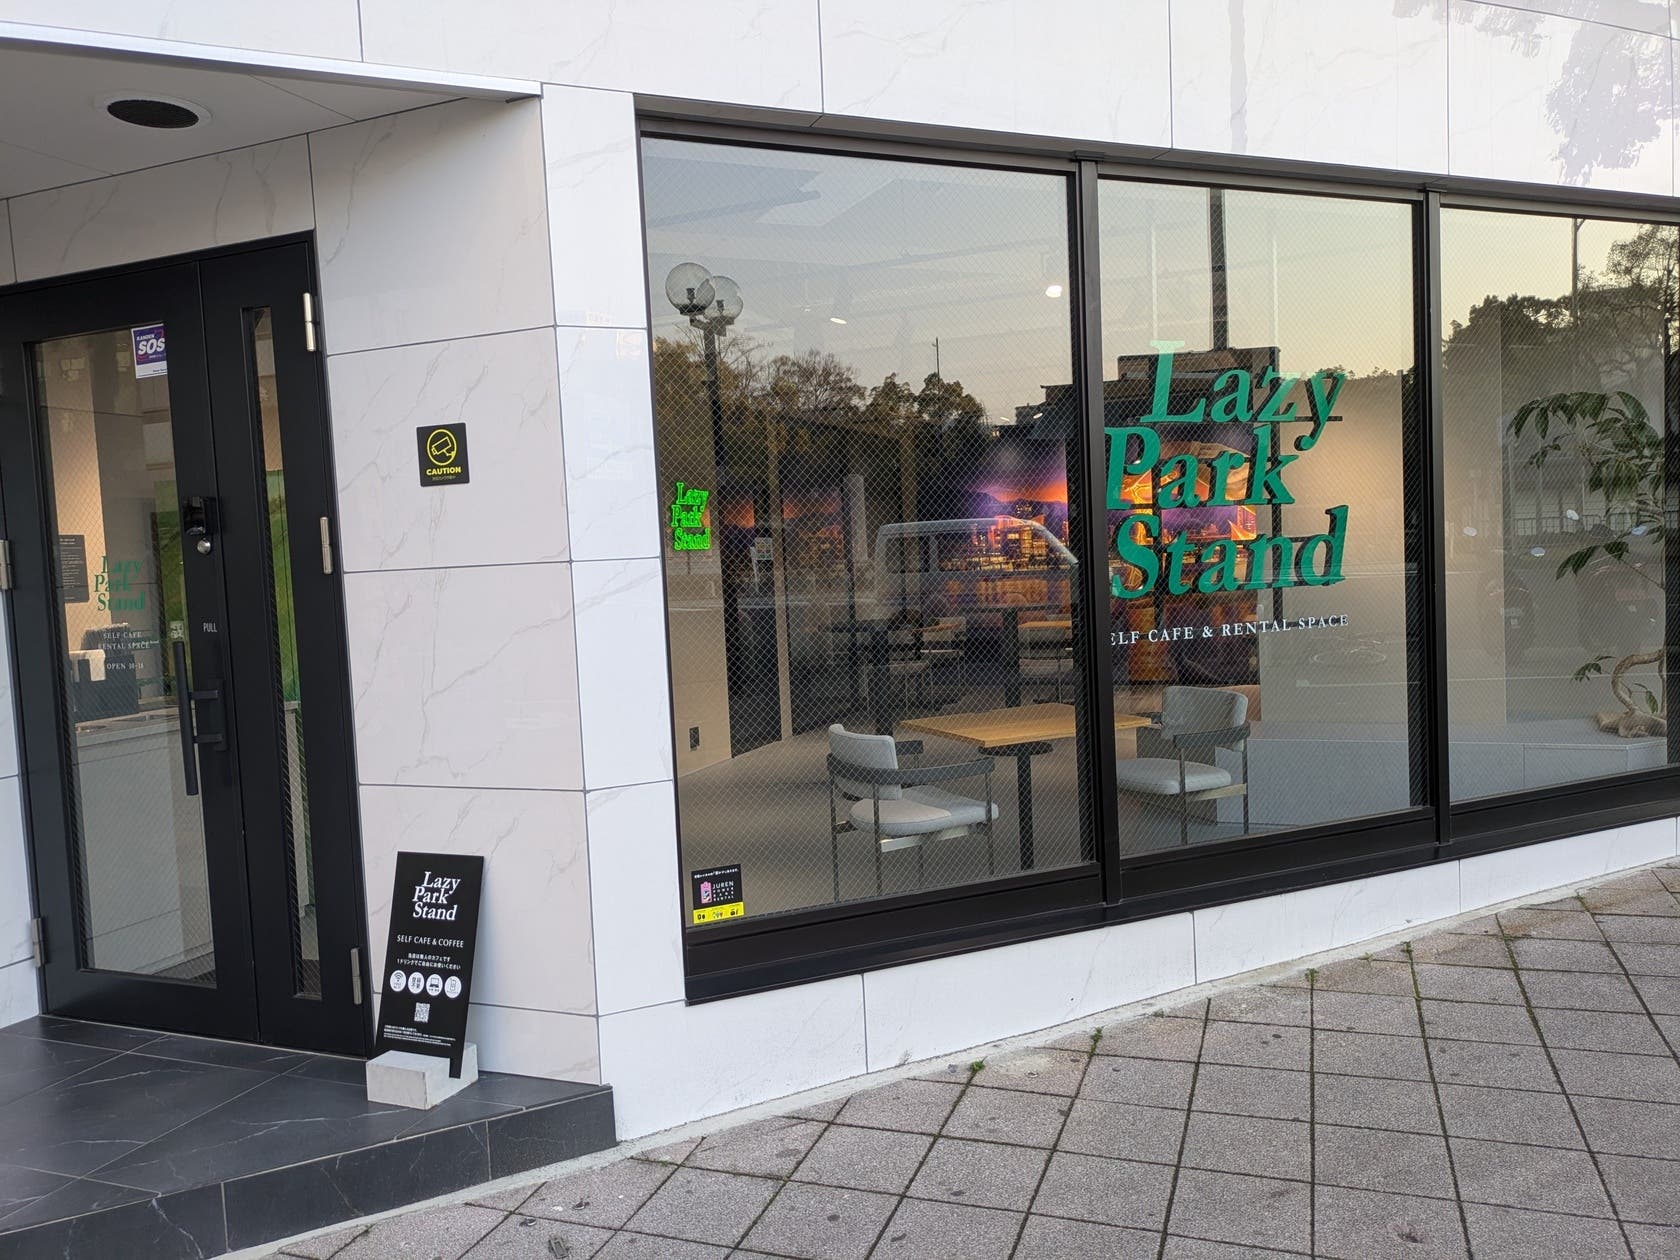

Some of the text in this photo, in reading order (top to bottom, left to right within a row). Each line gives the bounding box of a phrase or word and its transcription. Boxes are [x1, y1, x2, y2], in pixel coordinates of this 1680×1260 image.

[138, 338, 165, 355] SOS
[1140, 340, 1347, 451] Lazy
[426, 466, 462, 476] CAUTION
[1104, 424, 1300, 510] Park
[676, 482, 709, 513] Lazy
[671, 504, 702, 528] Park
[674, 527, 711, 550] Stand
[1111, 504, 1349, 600] Stand
[94, 574, 131, 592] Park
[97, 592, 145, 611] Stand
[103, 631, 120, 640] SELF
[203, 622, 218, 633] PULL
[1110, 614, 1349, 646] ELF CAFE & RENTAL SPACE
[106, 662, 126, 671] OPEN
[422, 871, 461, 895] Lazy
[412, 886, 449, 904] Park
[413, 902, 458, 920] Stand
[396, 934, 464, 948] SELF CAFE & COFFEE
